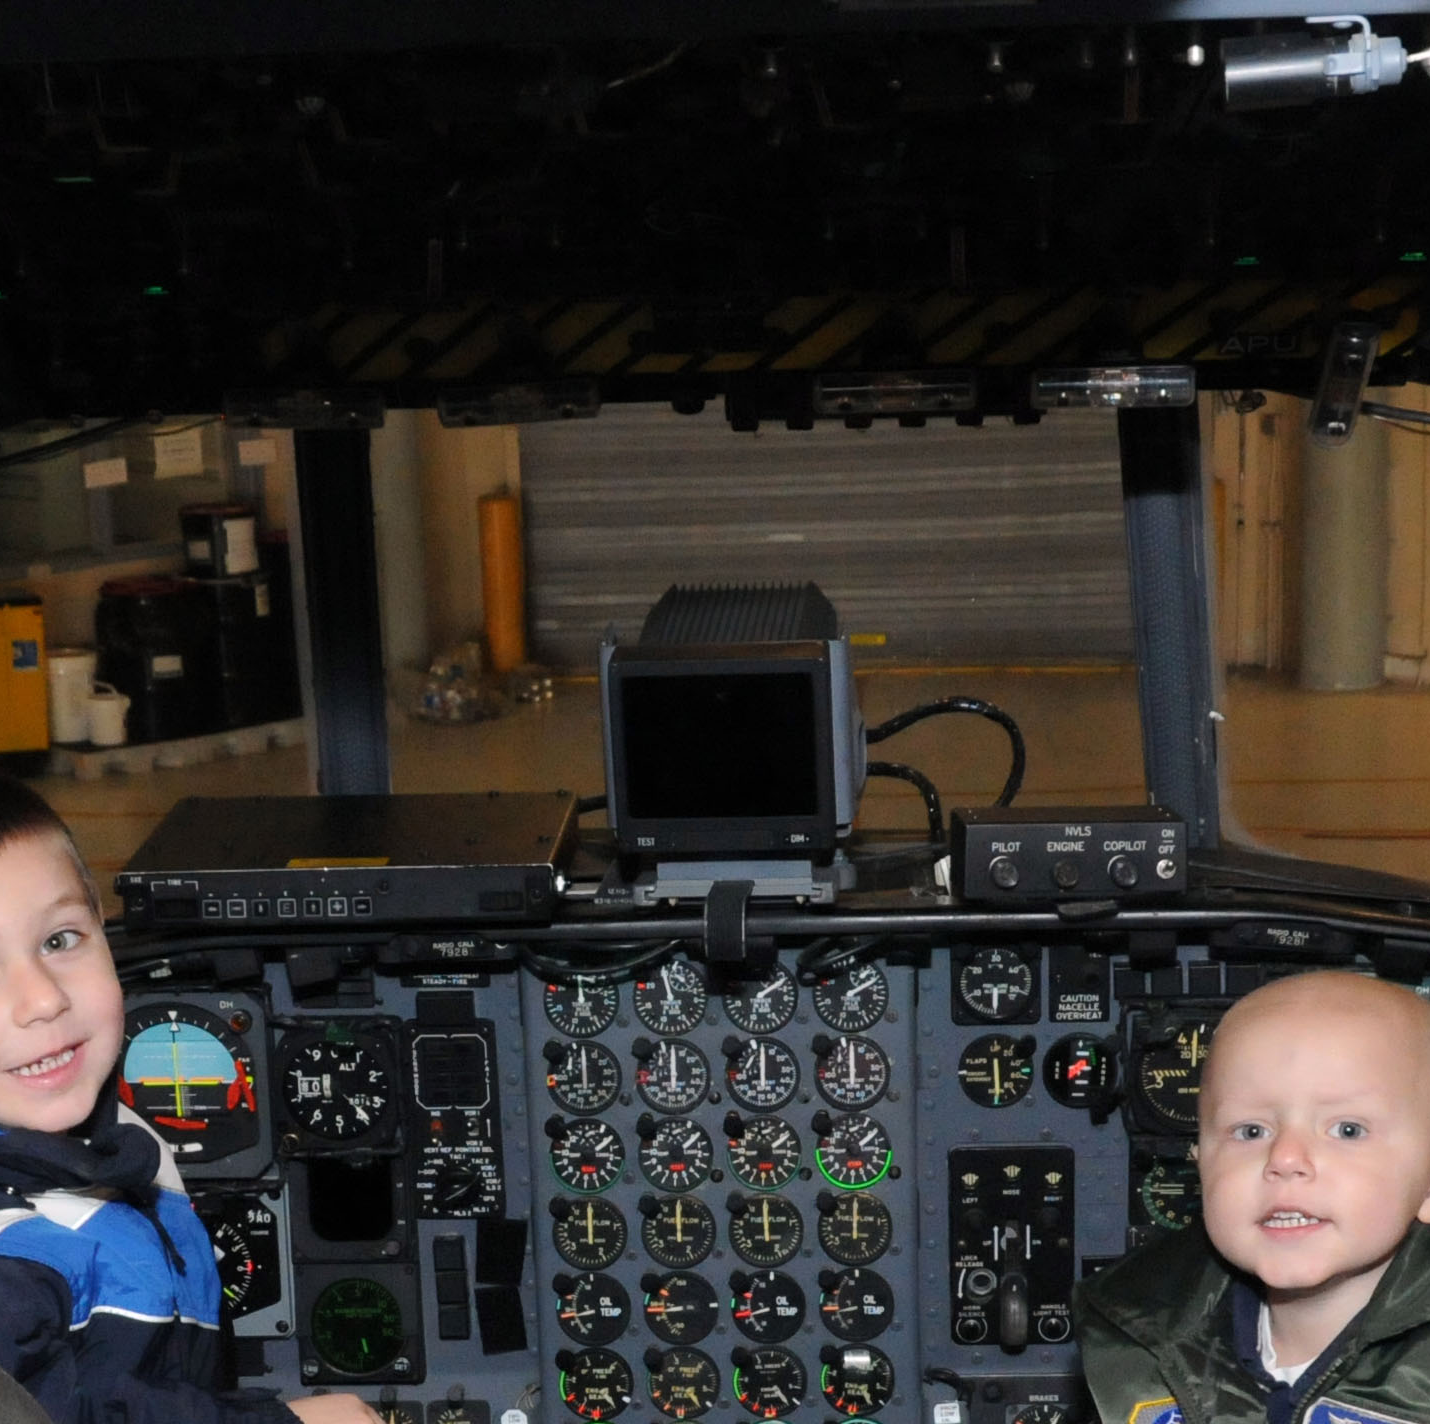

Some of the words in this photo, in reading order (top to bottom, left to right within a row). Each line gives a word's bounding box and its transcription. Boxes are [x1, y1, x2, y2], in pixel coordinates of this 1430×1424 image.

[1065, 826, 1092, 838] NVLS
[1161, 828, 1175, 839] ON
[637, 837, 655, 846] TEST
[1047, 841, 1085, 852] ENGINE
[1103, 840, 1147, 852] COPILOT
[992, 842, 1021, 852] PILOT
[1158, 844, 1175, 855] OFF
[1293, 931, 1309, 939] CALL
[1060, 994, 1099, 1003] CAUTION
[219, 1001, 233, 1009] DH
[1058, 1002, 1100, 1012] NACELLE
[1055, 1011, 1103, 1021] OVERHEAT
[313, 1051, 321, 1061] 9
[339, 1063, 356, 1071] ALT
[369, 1071, 377, 1082] 2
[313, 1111, 321, 1121] 6
[335, 1115, 343, 1126] 5
[599, 1297, 612, 1306] OIL
[776, 1296, 789, 1305] OIL
[863, 1295, 876, 1304] OIL
[600, 1308, 621, 1317] TEMP
[776, 1307, 798, 1316] TEMP
[863, 1306, 885, 1315] TEMP
